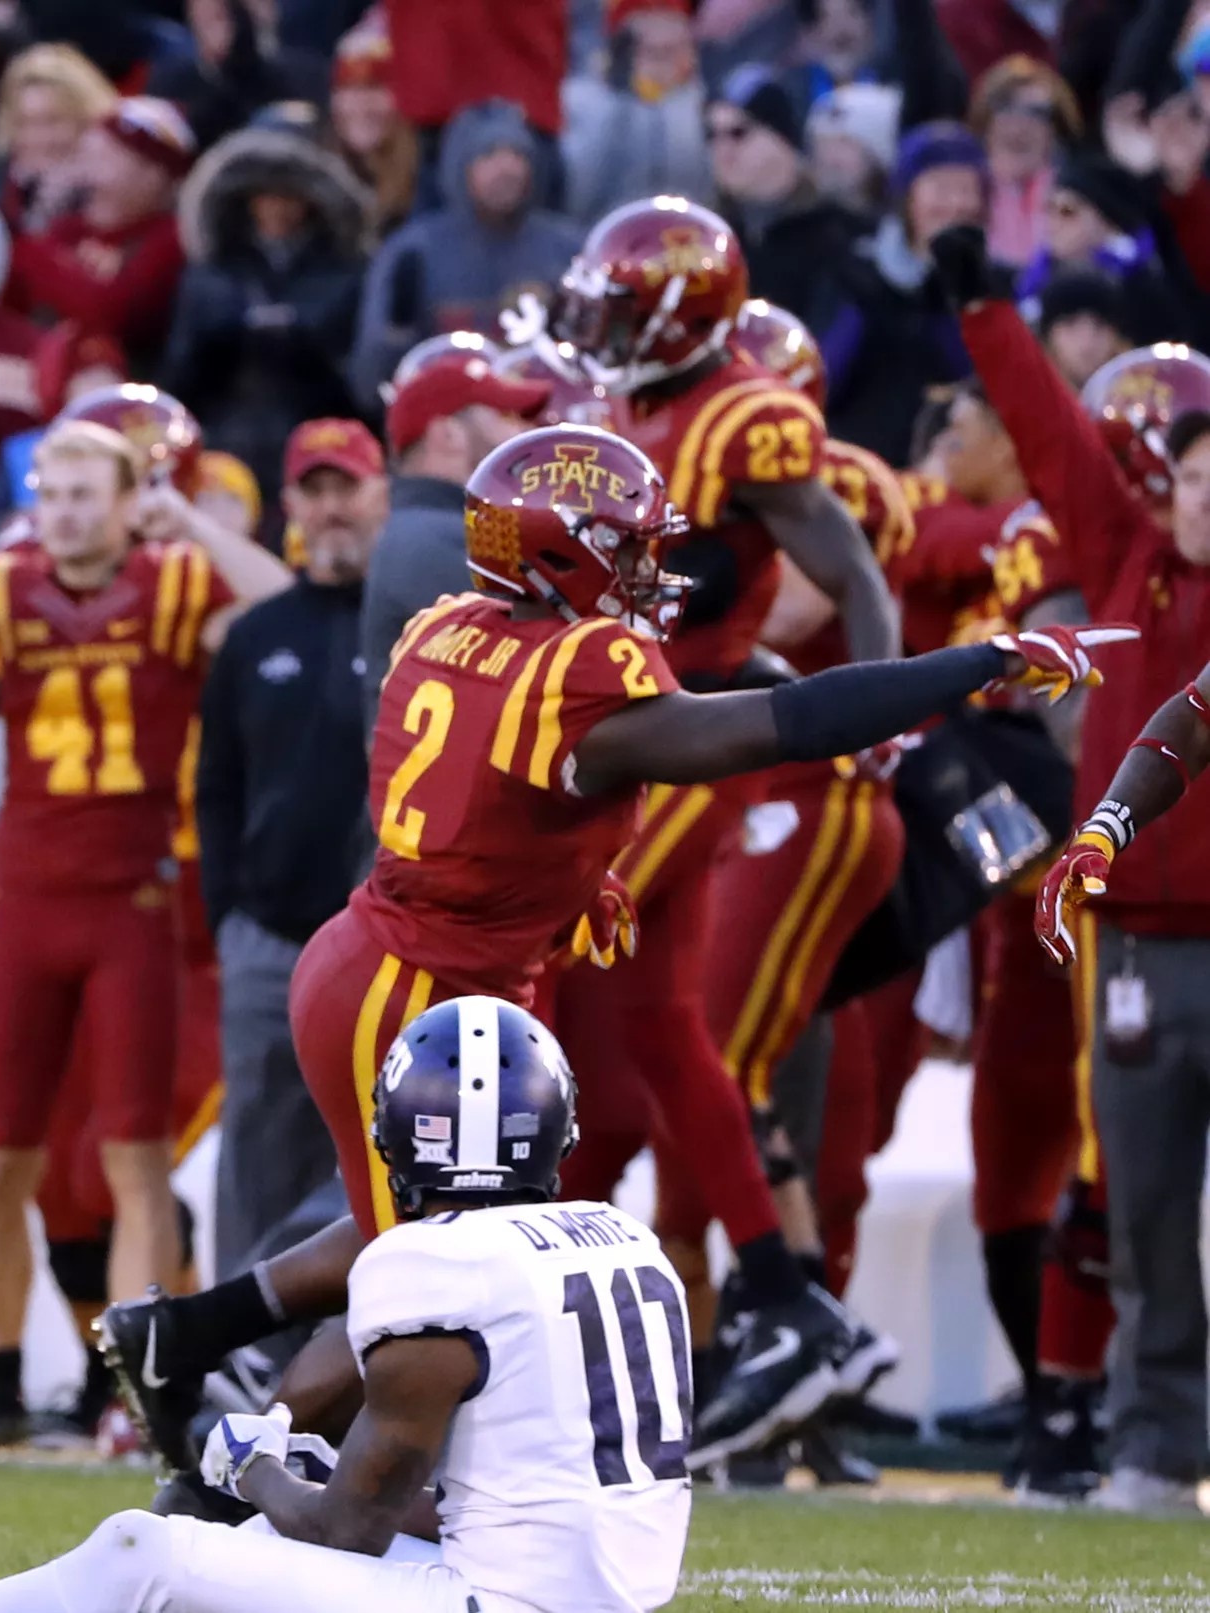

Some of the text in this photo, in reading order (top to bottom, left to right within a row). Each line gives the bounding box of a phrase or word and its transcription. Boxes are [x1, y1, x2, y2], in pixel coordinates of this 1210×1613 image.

[745, 417, 812, 482] 23
[521, 461, 627, 504] STATE
[477, 636, 522, 677] JR
[608, 637, 659, 698] 2
[27, 664, 146, 795] 41
[380, 679, 455, 861] 2
[511, 1142, 531, 1160] 10
[508, 1210, 639, 1251] D. WHITE
[562, 1265, 693, 1487] 10
